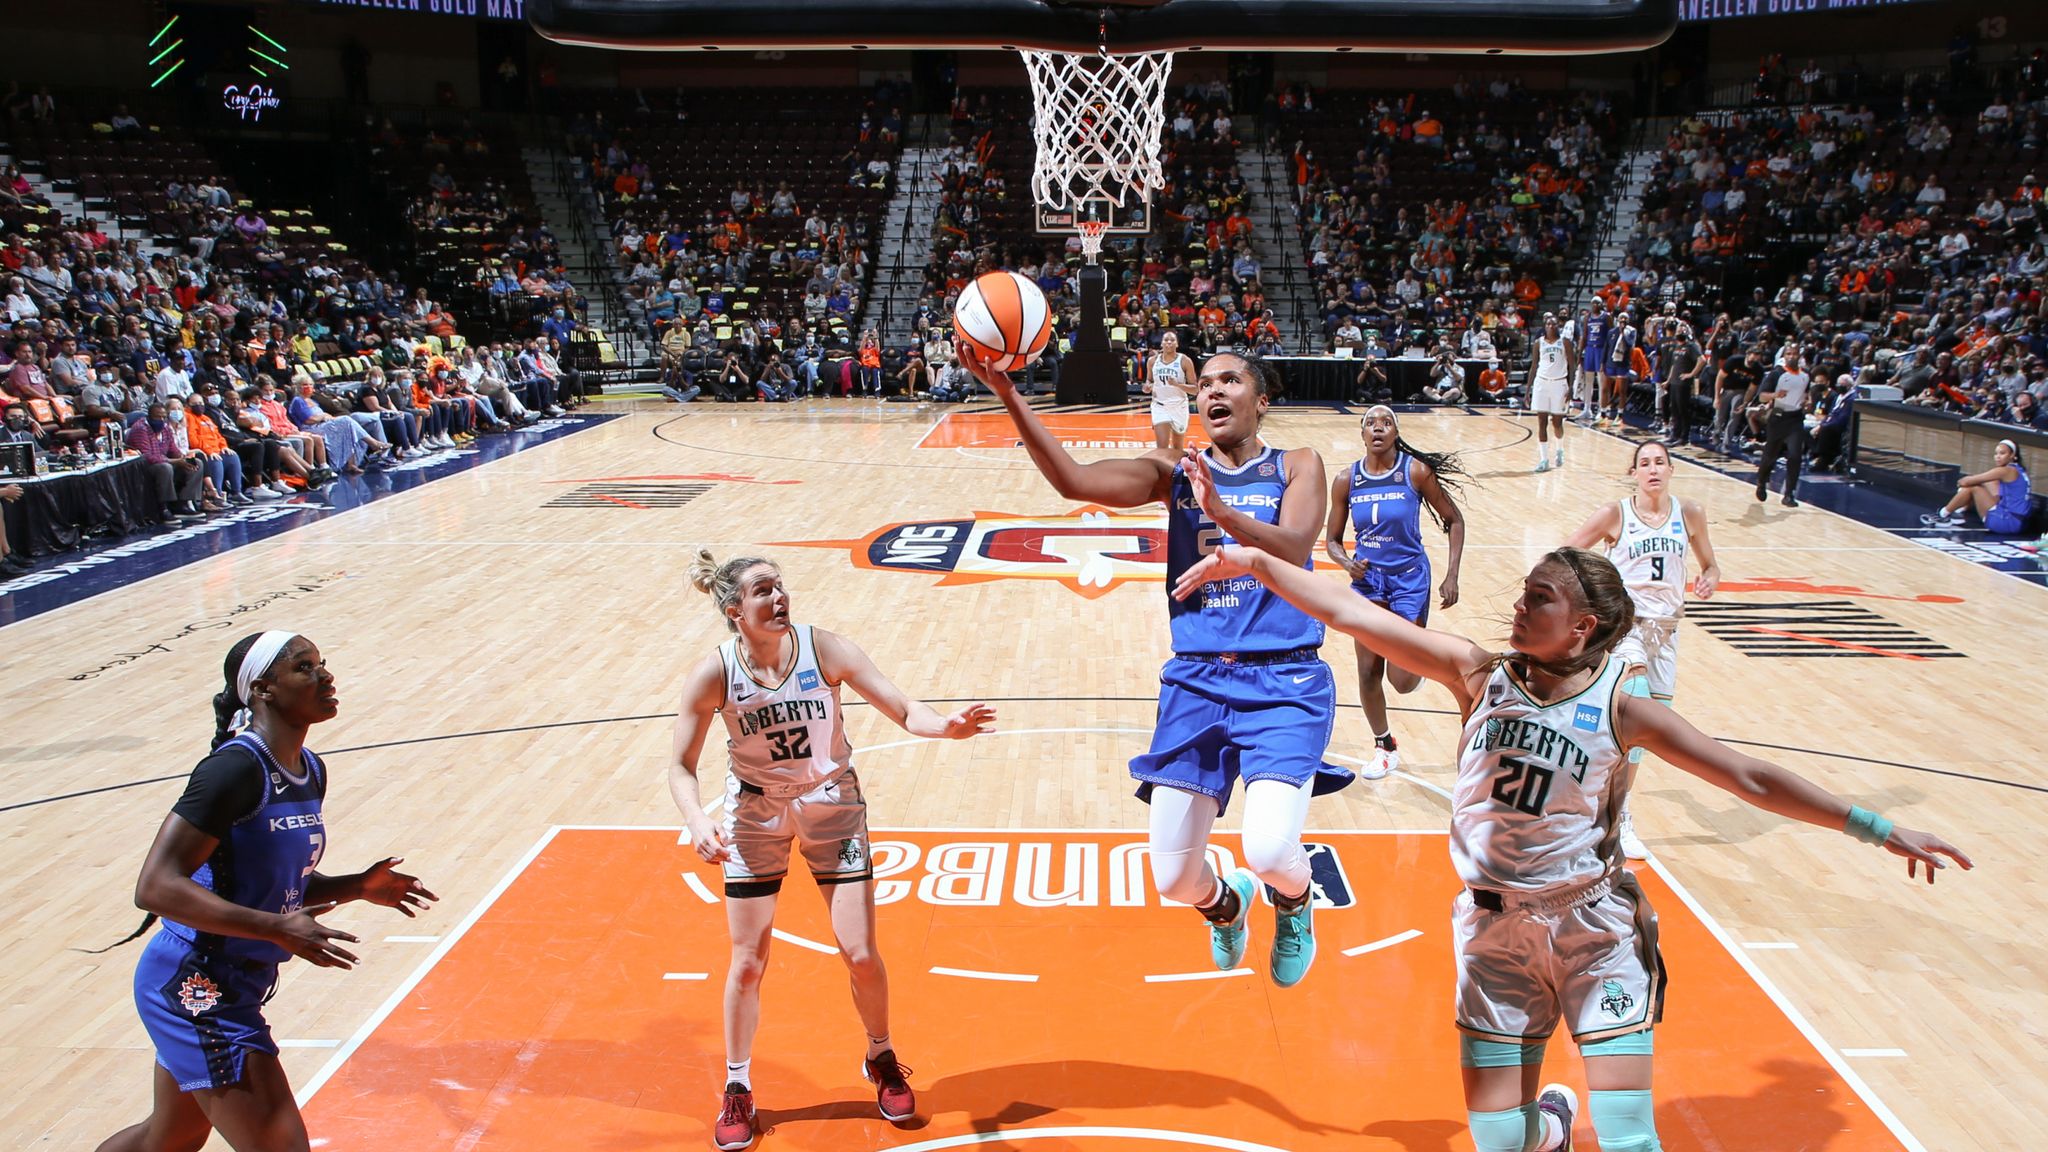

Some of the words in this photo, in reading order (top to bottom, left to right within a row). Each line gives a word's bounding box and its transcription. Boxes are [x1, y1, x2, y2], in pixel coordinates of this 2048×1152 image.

[1976, 15, 2007, 39] 13
[1176, 494, 1281, 510] KESUSK
[1350, 492, 1405, 504] KEESUSK
[1371, 503, 1379, 525] 1
[0, 508, 278, 596] CHANGEMAKER
[1629, 537, 1684, 560] LIBERTY
[1651, 557, 1664, 581] 9
[800, 676, 816, 686] HSS
[739, 700, 827, 736] LIBERTY
[1576, 711, 1598, 723] HSS
[765, 726, 812, 761] 32
[1472, 717, 1590, 785] LIBERTY
[1491, 756, 1554, 817] 20
